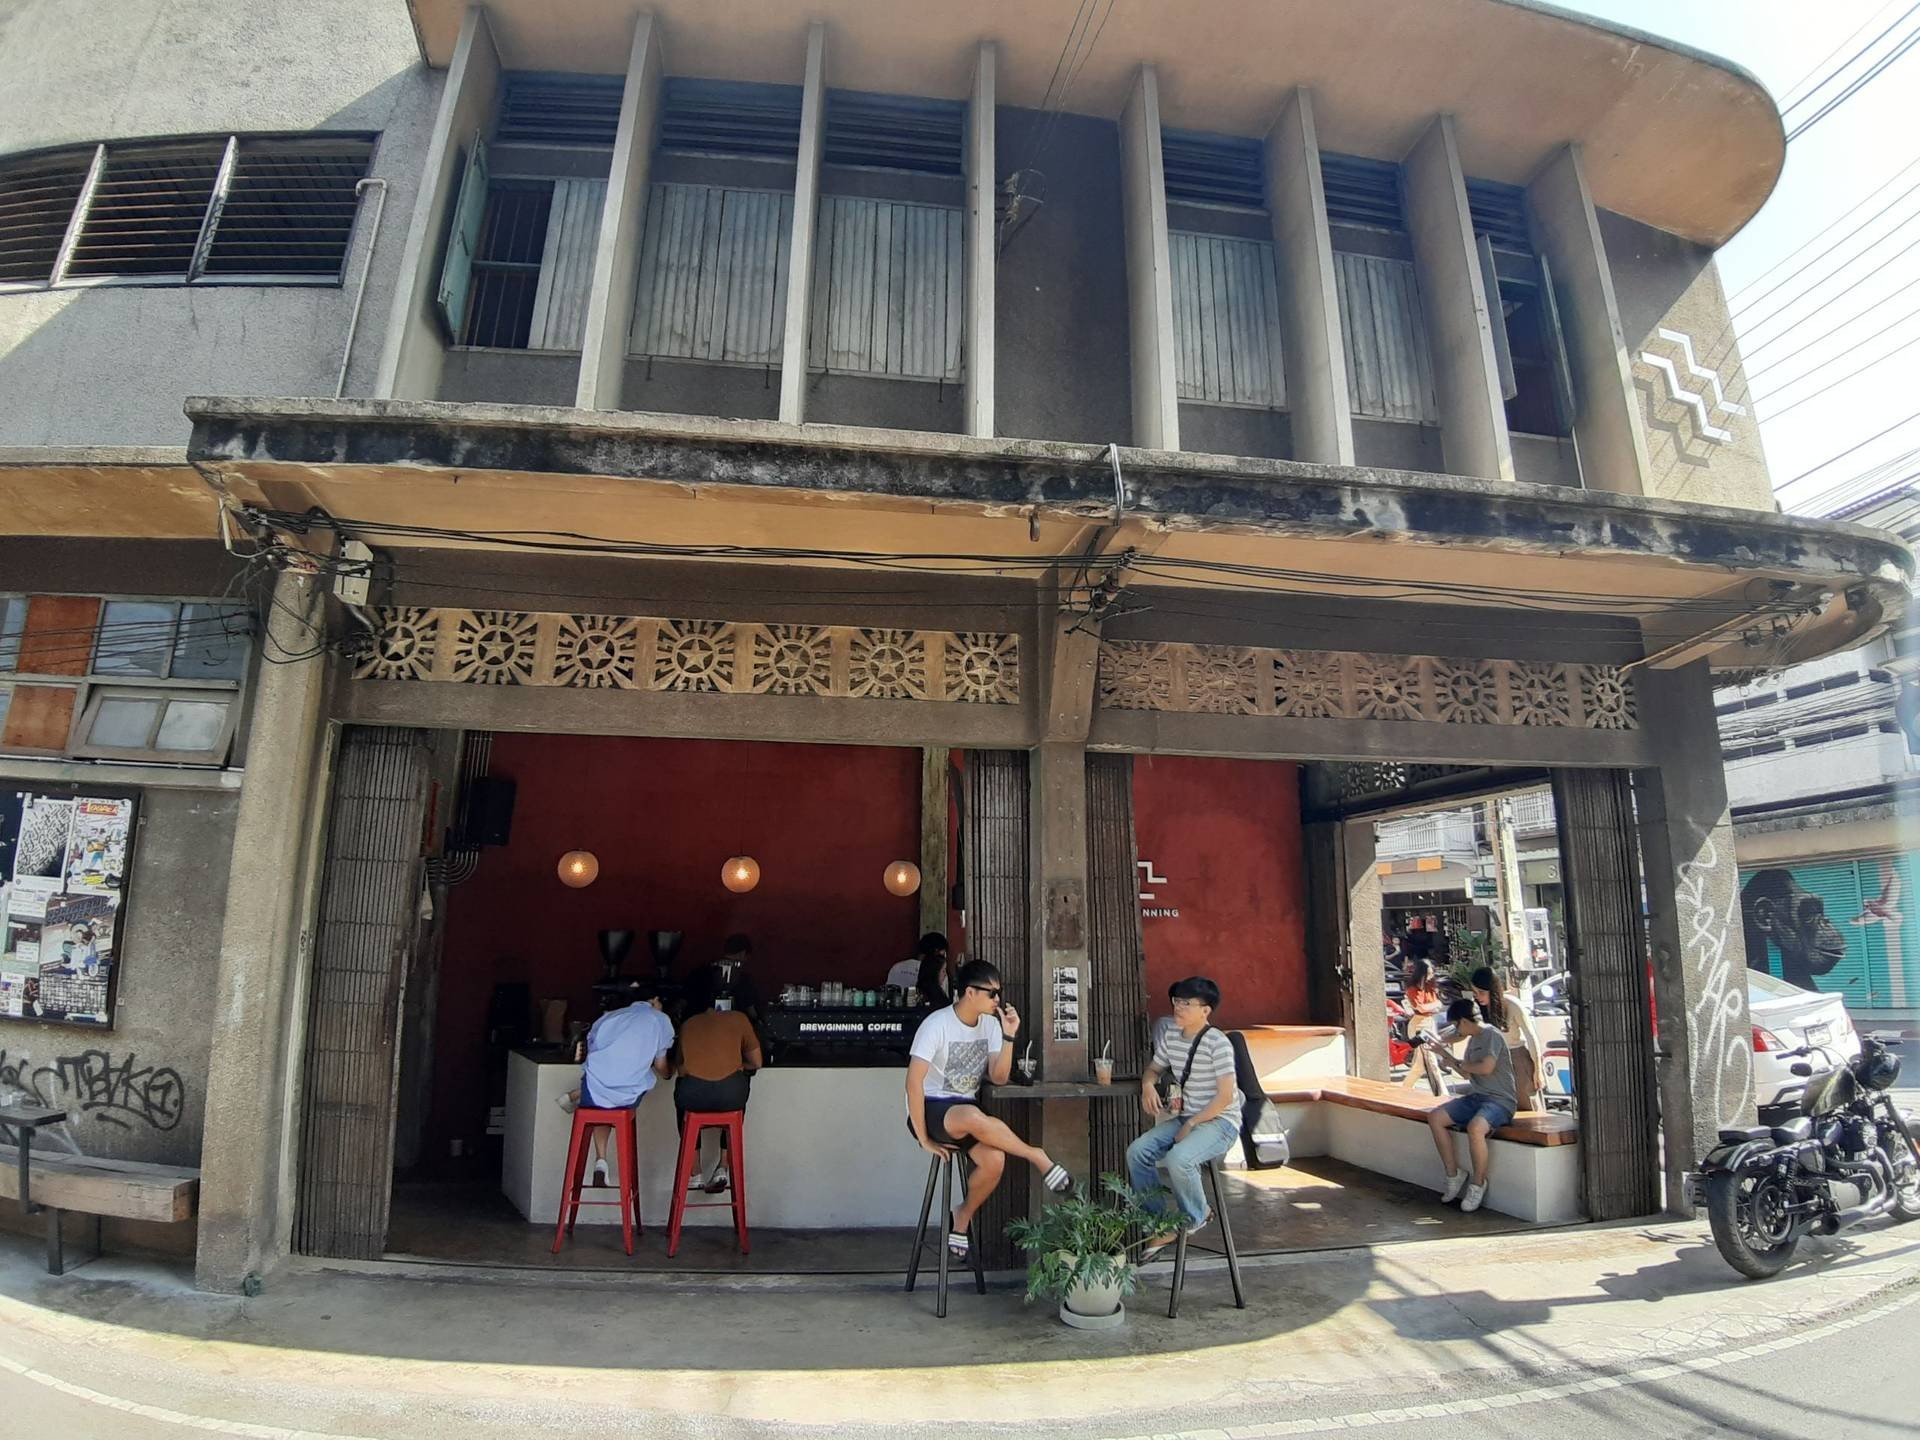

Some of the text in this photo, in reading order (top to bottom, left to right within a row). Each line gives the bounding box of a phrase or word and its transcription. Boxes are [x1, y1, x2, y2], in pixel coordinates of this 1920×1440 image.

[1142, 909, 1179, 917] NNING
[800, 1023, 902, 1032] BREWGINNING COFFEE
